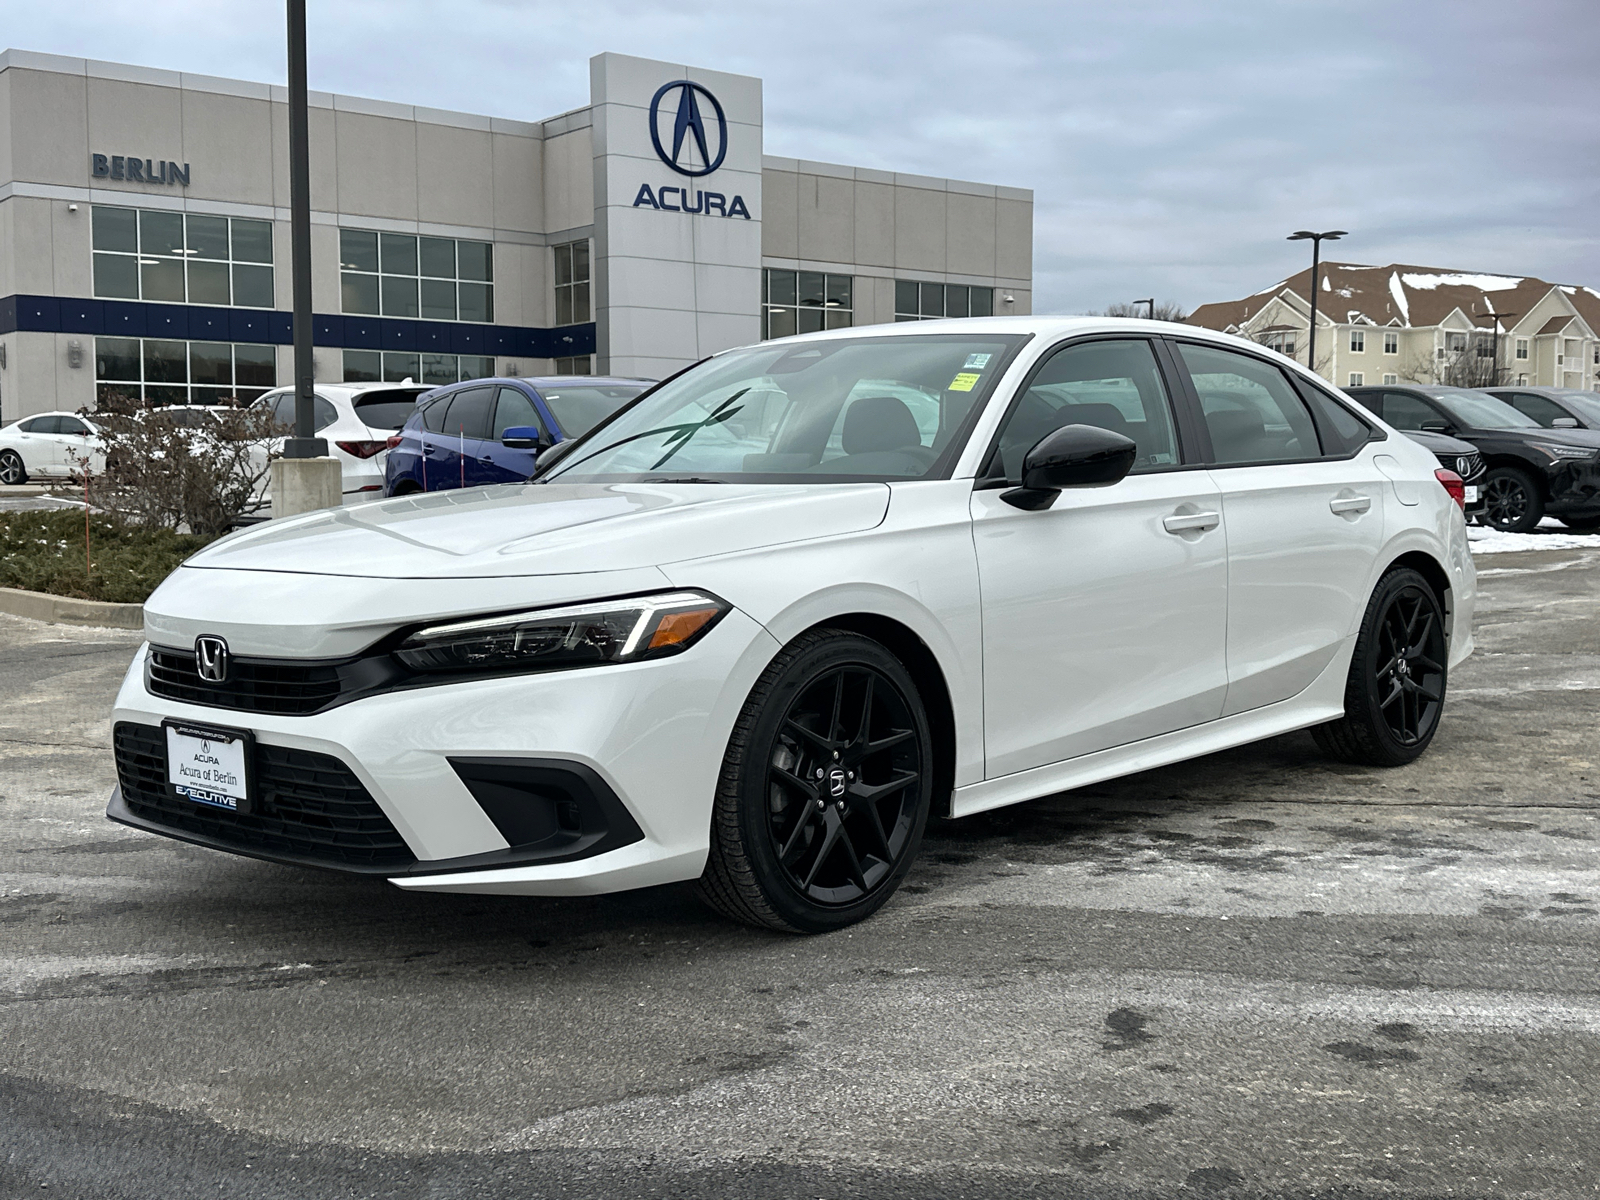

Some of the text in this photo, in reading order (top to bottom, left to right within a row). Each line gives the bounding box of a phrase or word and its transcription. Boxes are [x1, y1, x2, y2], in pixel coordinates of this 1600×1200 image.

[92, 153, 190, 186] BERLIN
[633, 183, 751, 220] ACURA
[194, 754, 220, 765] ACURA
[180, 763, 237, 786] Acura of Berlin
[176, 785, 237, 806] EXECUTIVE
